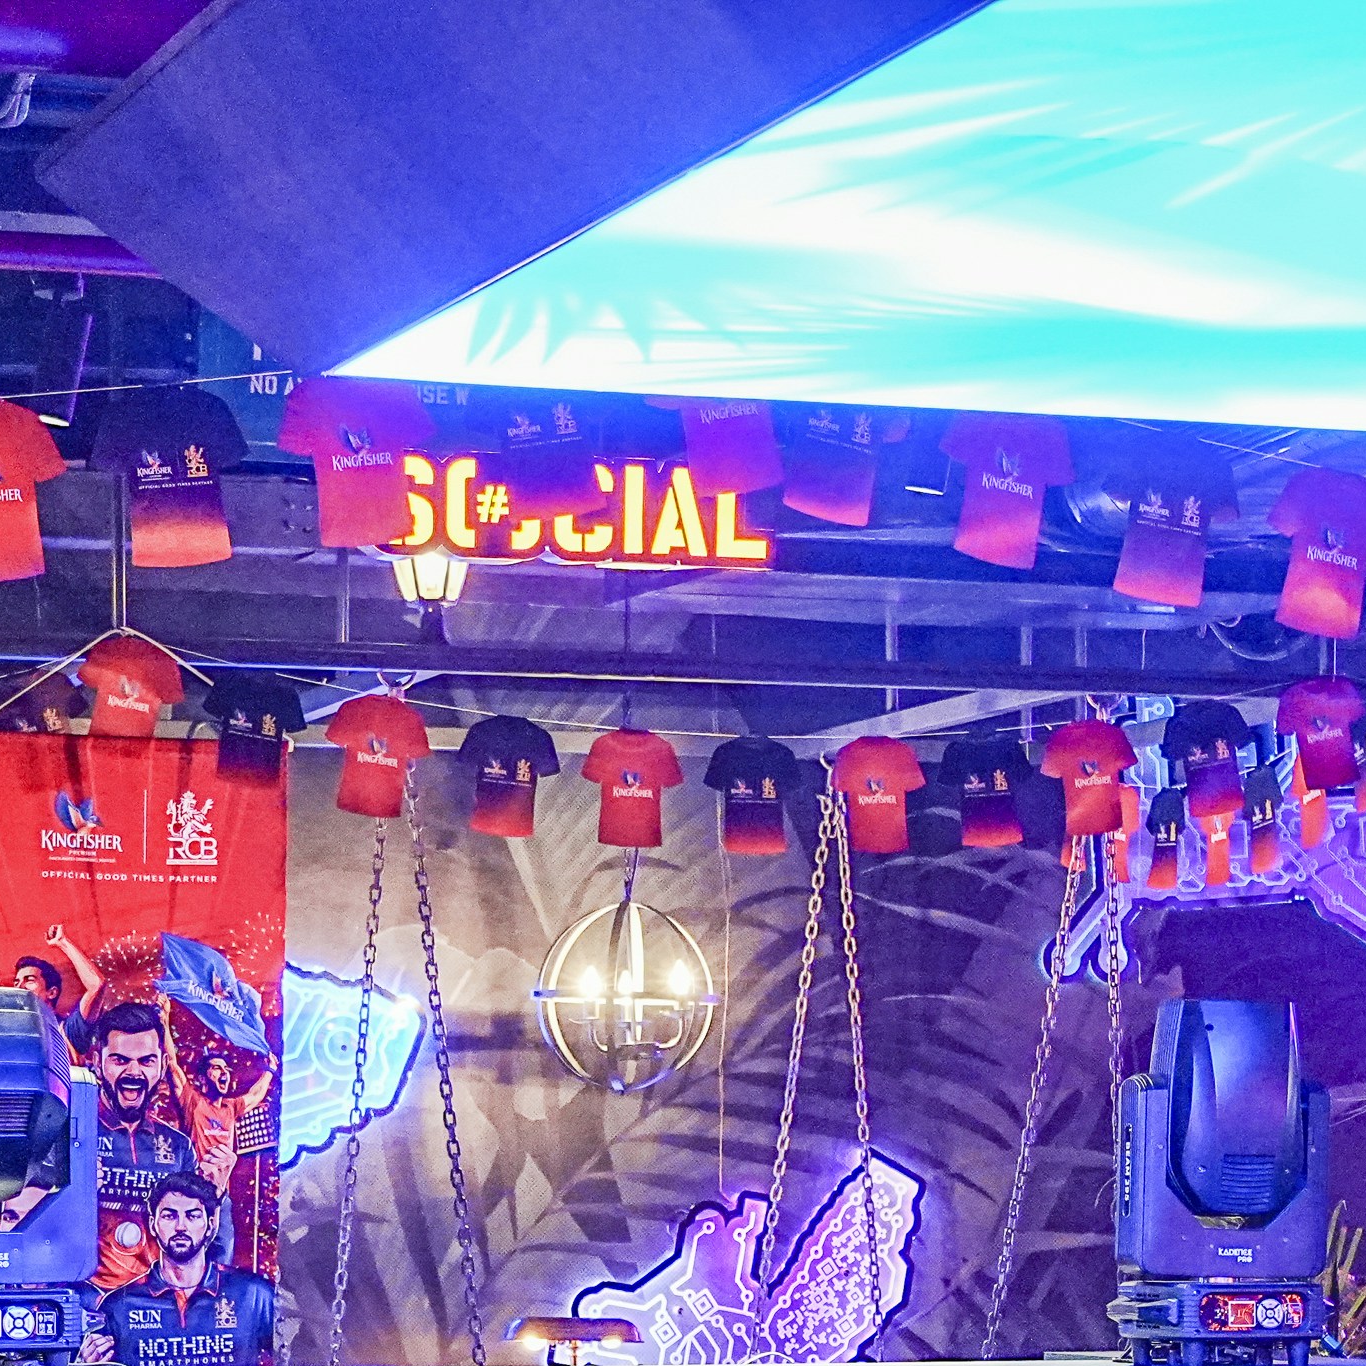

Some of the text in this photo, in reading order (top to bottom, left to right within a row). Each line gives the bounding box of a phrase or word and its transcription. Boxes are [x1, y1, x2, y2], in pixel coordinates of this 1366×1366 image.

[700, 401, 759, 424] KINGFISHER
[332, 450, 394, 471] KINGFISHER
[982, 472, 1034, 499] KINGFISHER
[1307, 545, 1358, 570] KINGFISHER
[41, 829, 123, 853] KINGFISHER
[166, 836, 218, 860] RCB
[41, 870, 218, 884] OFFICIAL GOOD TIMES PARTNER
[187, 979, 245, 1023] KINGFISHER
[128, 1309, 162, 1323] SUN
[129, 1322, 163, 1330] PHARMA
[139, 1333, 234, 1358] NOTHING
